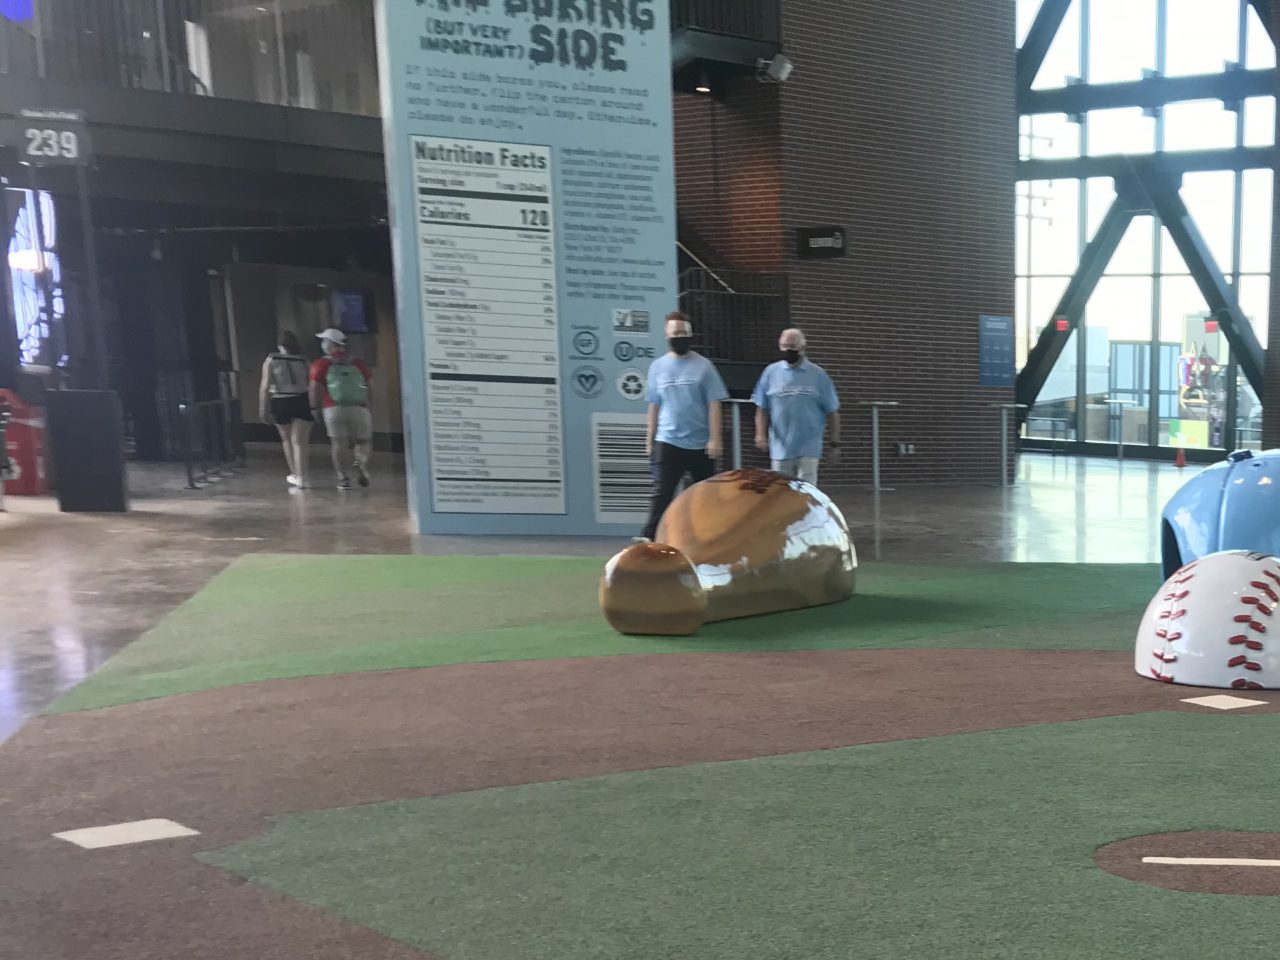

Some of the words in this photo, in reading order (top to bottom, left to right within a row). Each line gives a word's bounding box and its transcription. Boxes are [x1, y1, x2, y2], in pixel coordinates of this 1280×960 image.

[468, 23, 512, 41] VERY
[420, 36, 525, 60] IMPORTANT)
[528, 24, 628, 72] SIDE
[25, 128, 78, 158] 239
[415, 140, 495, 166] Nutrition
[499, 147, 547, 169] Facts
[420, 205, 471, 221] Calories
[520, 208, 549, 227] 120
